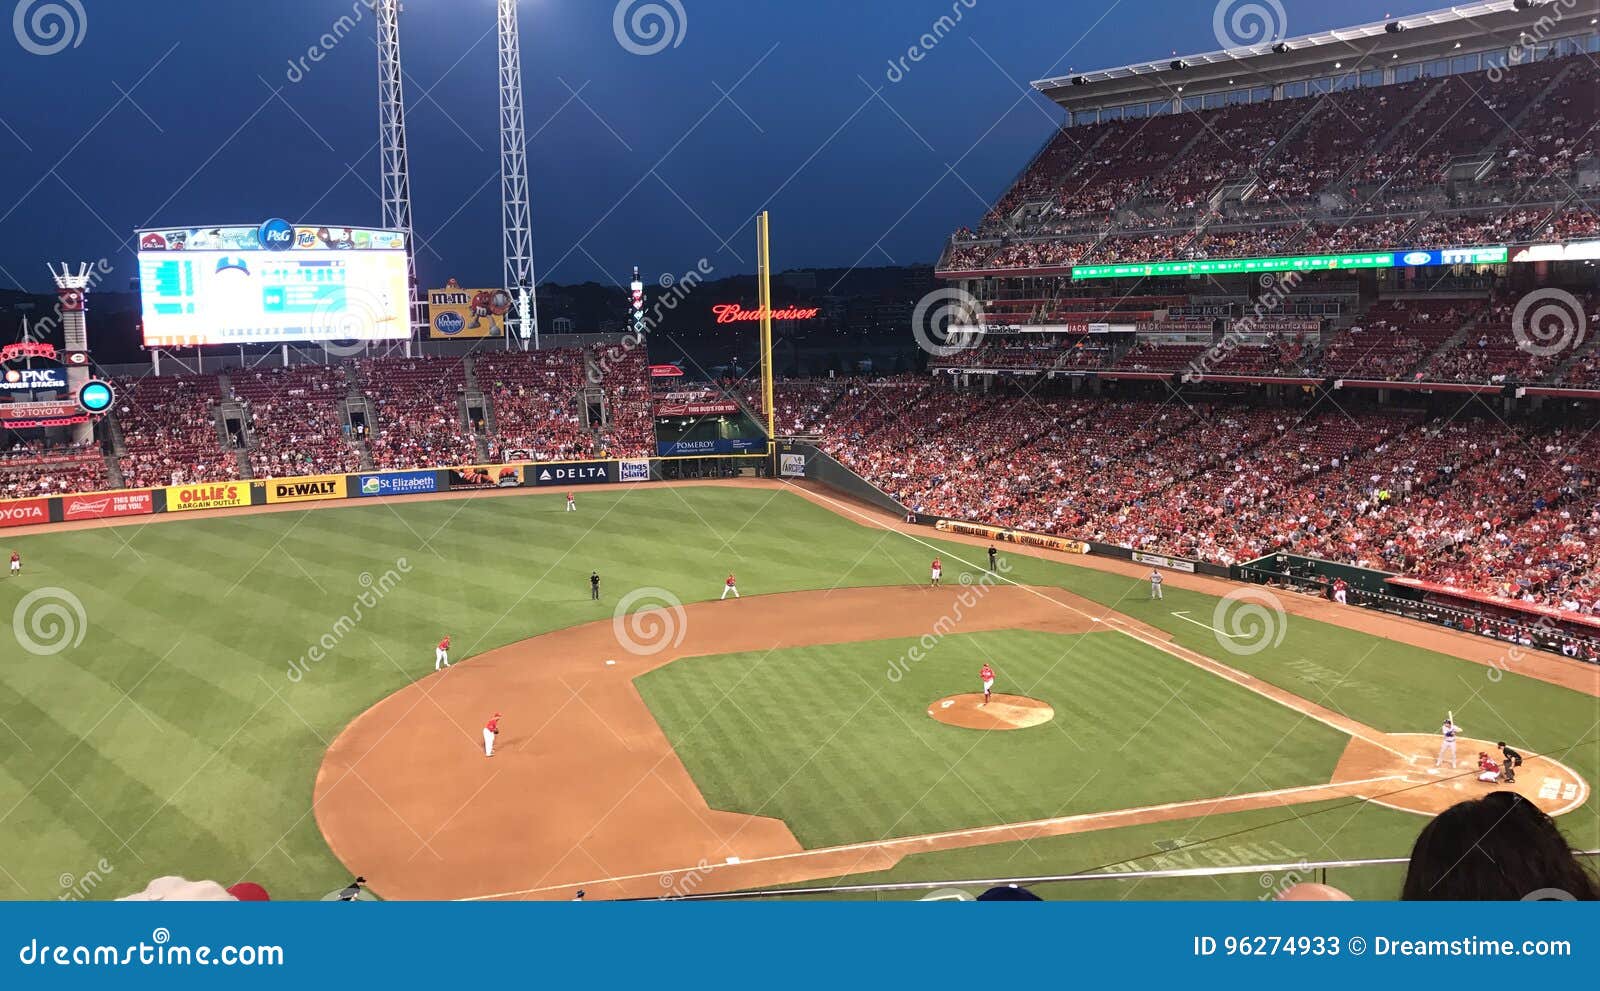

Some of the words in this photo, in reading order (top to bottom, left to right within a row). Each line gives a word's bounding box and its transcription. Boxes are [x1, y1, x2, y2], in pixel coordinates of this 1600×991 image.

[266, 229, 290, 241] P&G
[297, 232, 316, 246] Tide
[437, 314, 462, 332] Kroger
[1069, 324, 1088, 332] JACK
[21, 370, 55, 381] PNC
[31, 380, 65, 388] STACKS
[27, 407, 64, 416] TOYOTA
[676, 441, 715, 449] POMEROY
[556, 467, 606, 478] DELTA
[621, 462, 648, 472] Kings
[621, 469, 648, 480] Island
[392, 477, 434, 487] Elizabeth
[114, 503, 127, 511] FOR
[953, 525, 973, 536] GORILLA
[1020, 535, 1044, 546] GORILLA
